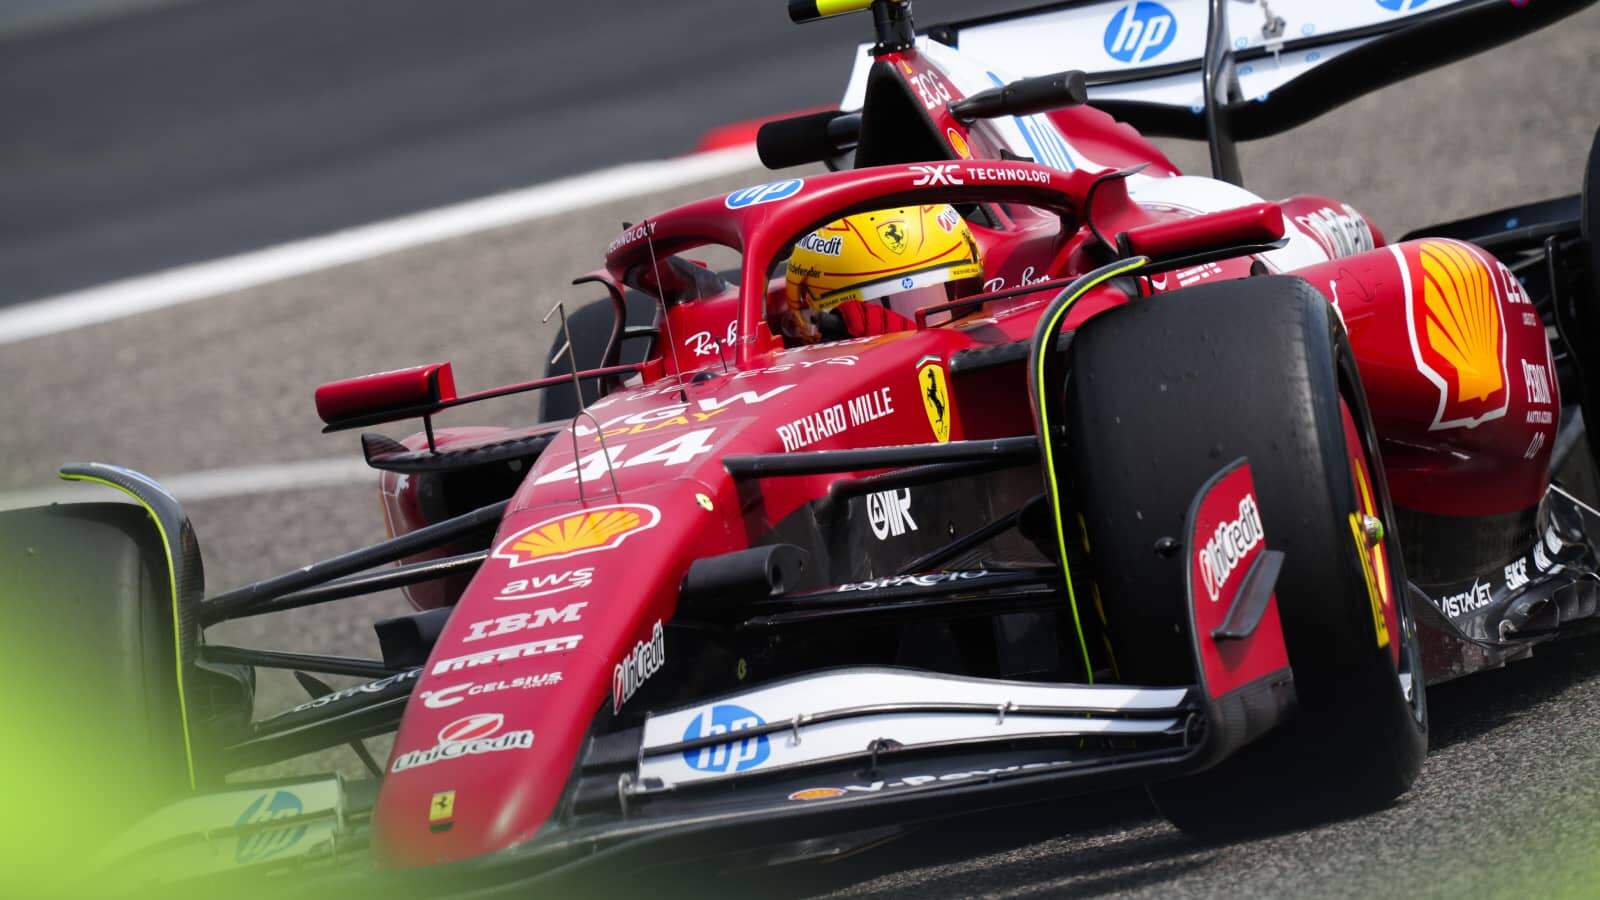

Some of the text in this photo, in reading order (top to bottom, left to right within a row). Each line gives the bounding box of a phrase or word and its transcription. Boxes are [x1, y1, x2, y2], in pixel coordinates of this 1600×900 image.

[1109, 1, 1173, 63] hp
[908, 165, 1050, 186] DXC TECHNOLOGY
[684, 320, 737, 357] Ray-B
[568, 384, 798, 436] VGW
[595, 407, 729, 442] PLAY
[776, 386, 894, 453] RICHARD MILLE
[533, 427, 717, 485] 44
[1206, 495, 1262, 586] UniCredit
[502, 567, 594, 595] aws
[1505, 557, 1530, 591] SKF
[463, 602, 588, 642] IBM
[432, 635, 583, 675] PIRELLI
[621, 619, 664, 704] UniCredit
[468, 672, 562, 695] CELSIUS
[394, 731, 533, 773] UniCredit
[692, 705, 763, 772] hp
